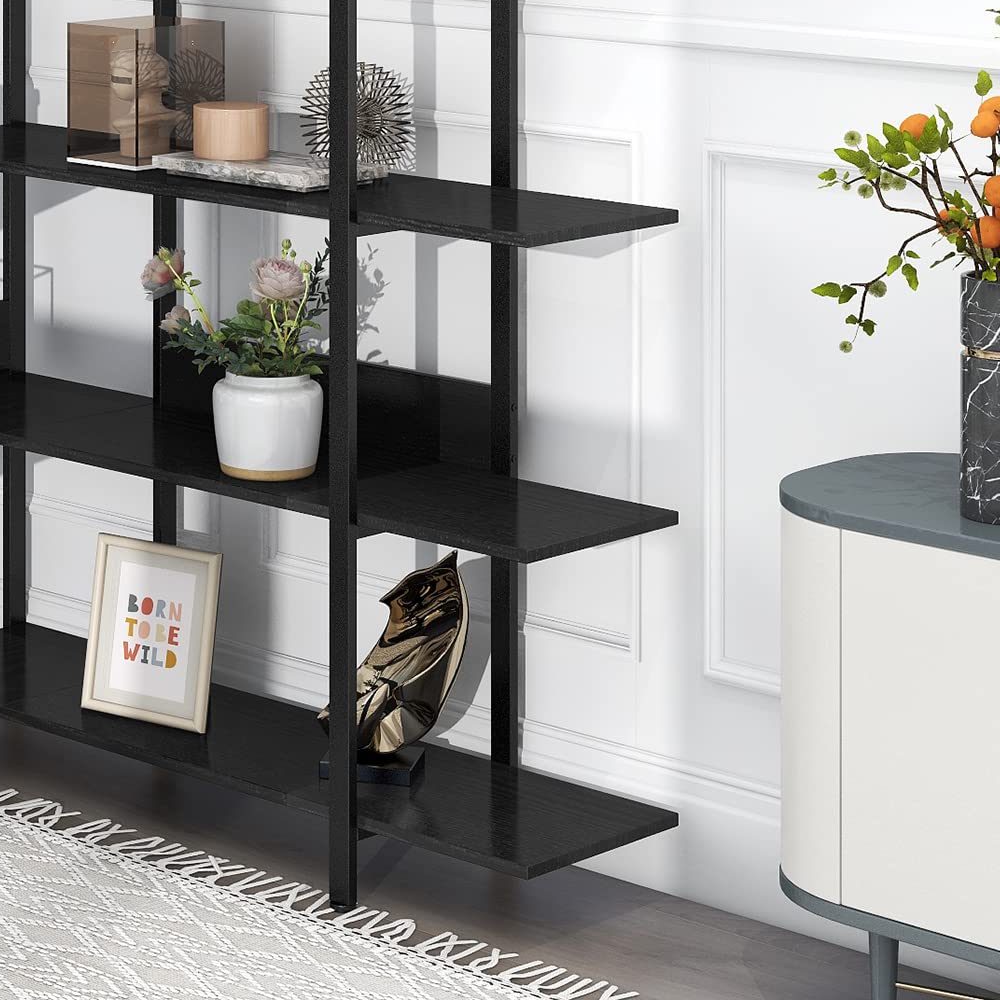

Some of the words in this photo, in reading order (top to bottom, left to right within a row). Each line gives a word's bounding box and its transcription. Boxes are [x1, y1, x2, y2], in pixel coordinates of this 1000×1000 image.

[128, 593, 183, 622] BORN
[125, 617, 151, 640] TO
[155, 623, 180, 646] BE
[122, 641, 177, 669] WILD
